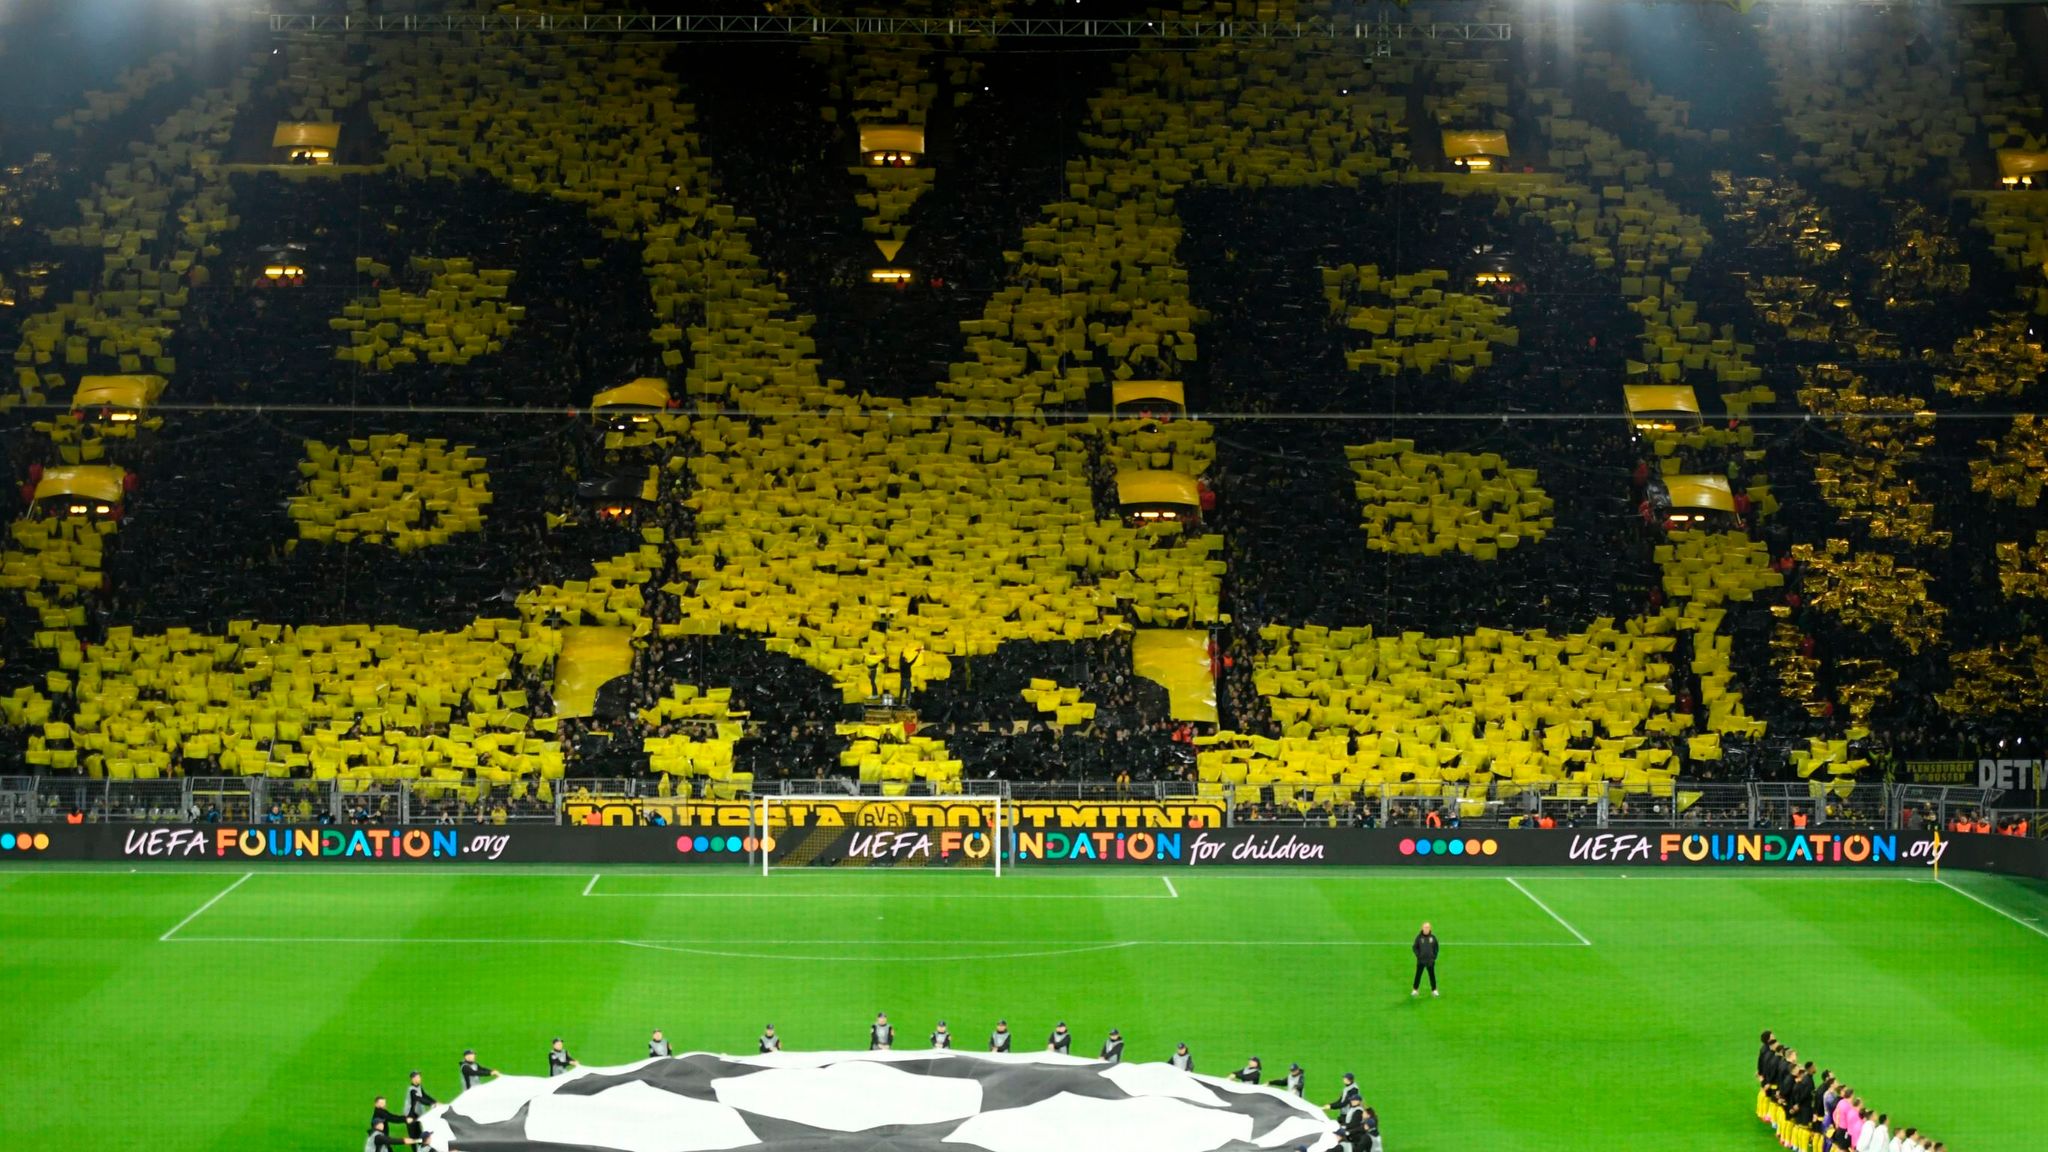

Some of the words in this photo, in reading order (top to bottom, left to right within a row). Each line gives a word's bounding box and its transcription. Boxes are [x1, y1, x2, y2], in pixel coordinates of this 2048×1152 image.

[1905, 762, 1975, 773] FLENSBURGER
[124, 828, 209, 857] UEFA
[216, 828, 457, 858] FOUNDATION
[848, 831, 934, 859] UEFA
[1189, 832, 1226, 866] for
[1231, 834, 1325, 860] children
[1568, 833, 1653, 861] UEFA
[1660, 833, 1897, 862] FOUNDATION
